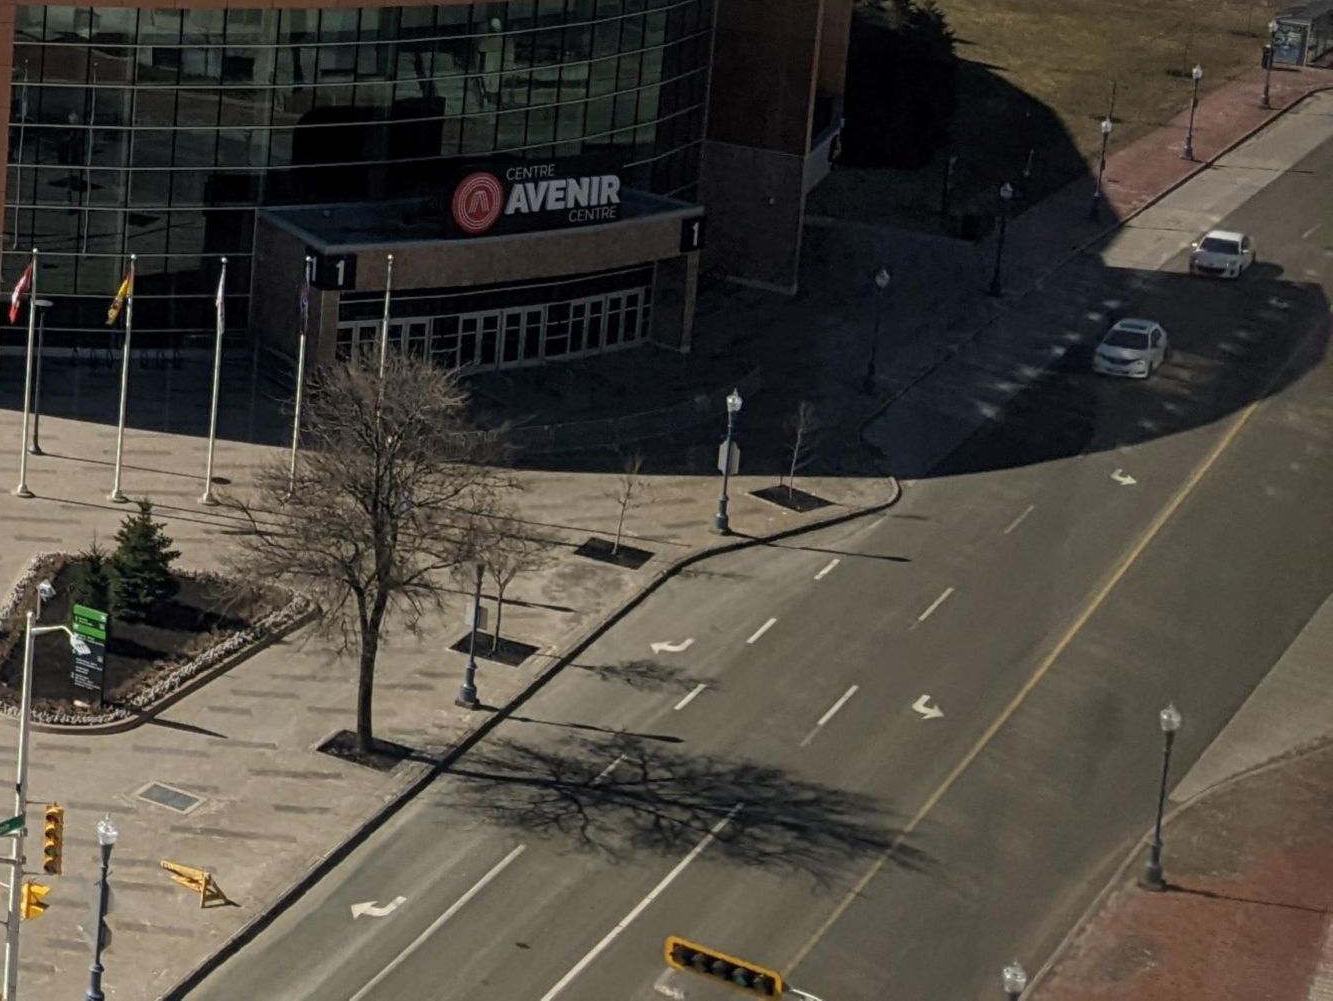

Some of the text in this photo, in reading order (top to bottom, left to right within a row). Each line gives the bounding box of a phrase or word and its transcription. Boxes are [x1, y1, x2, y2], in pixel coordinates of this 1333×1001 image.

[505, 163, 557, 181] CENTRE
[503, 174, 621, 215] AVENIR
[568, 205, 618, 223] CENTRE
[693, 221, 700, 247] 1
[336, 259, 345, 286] 1
